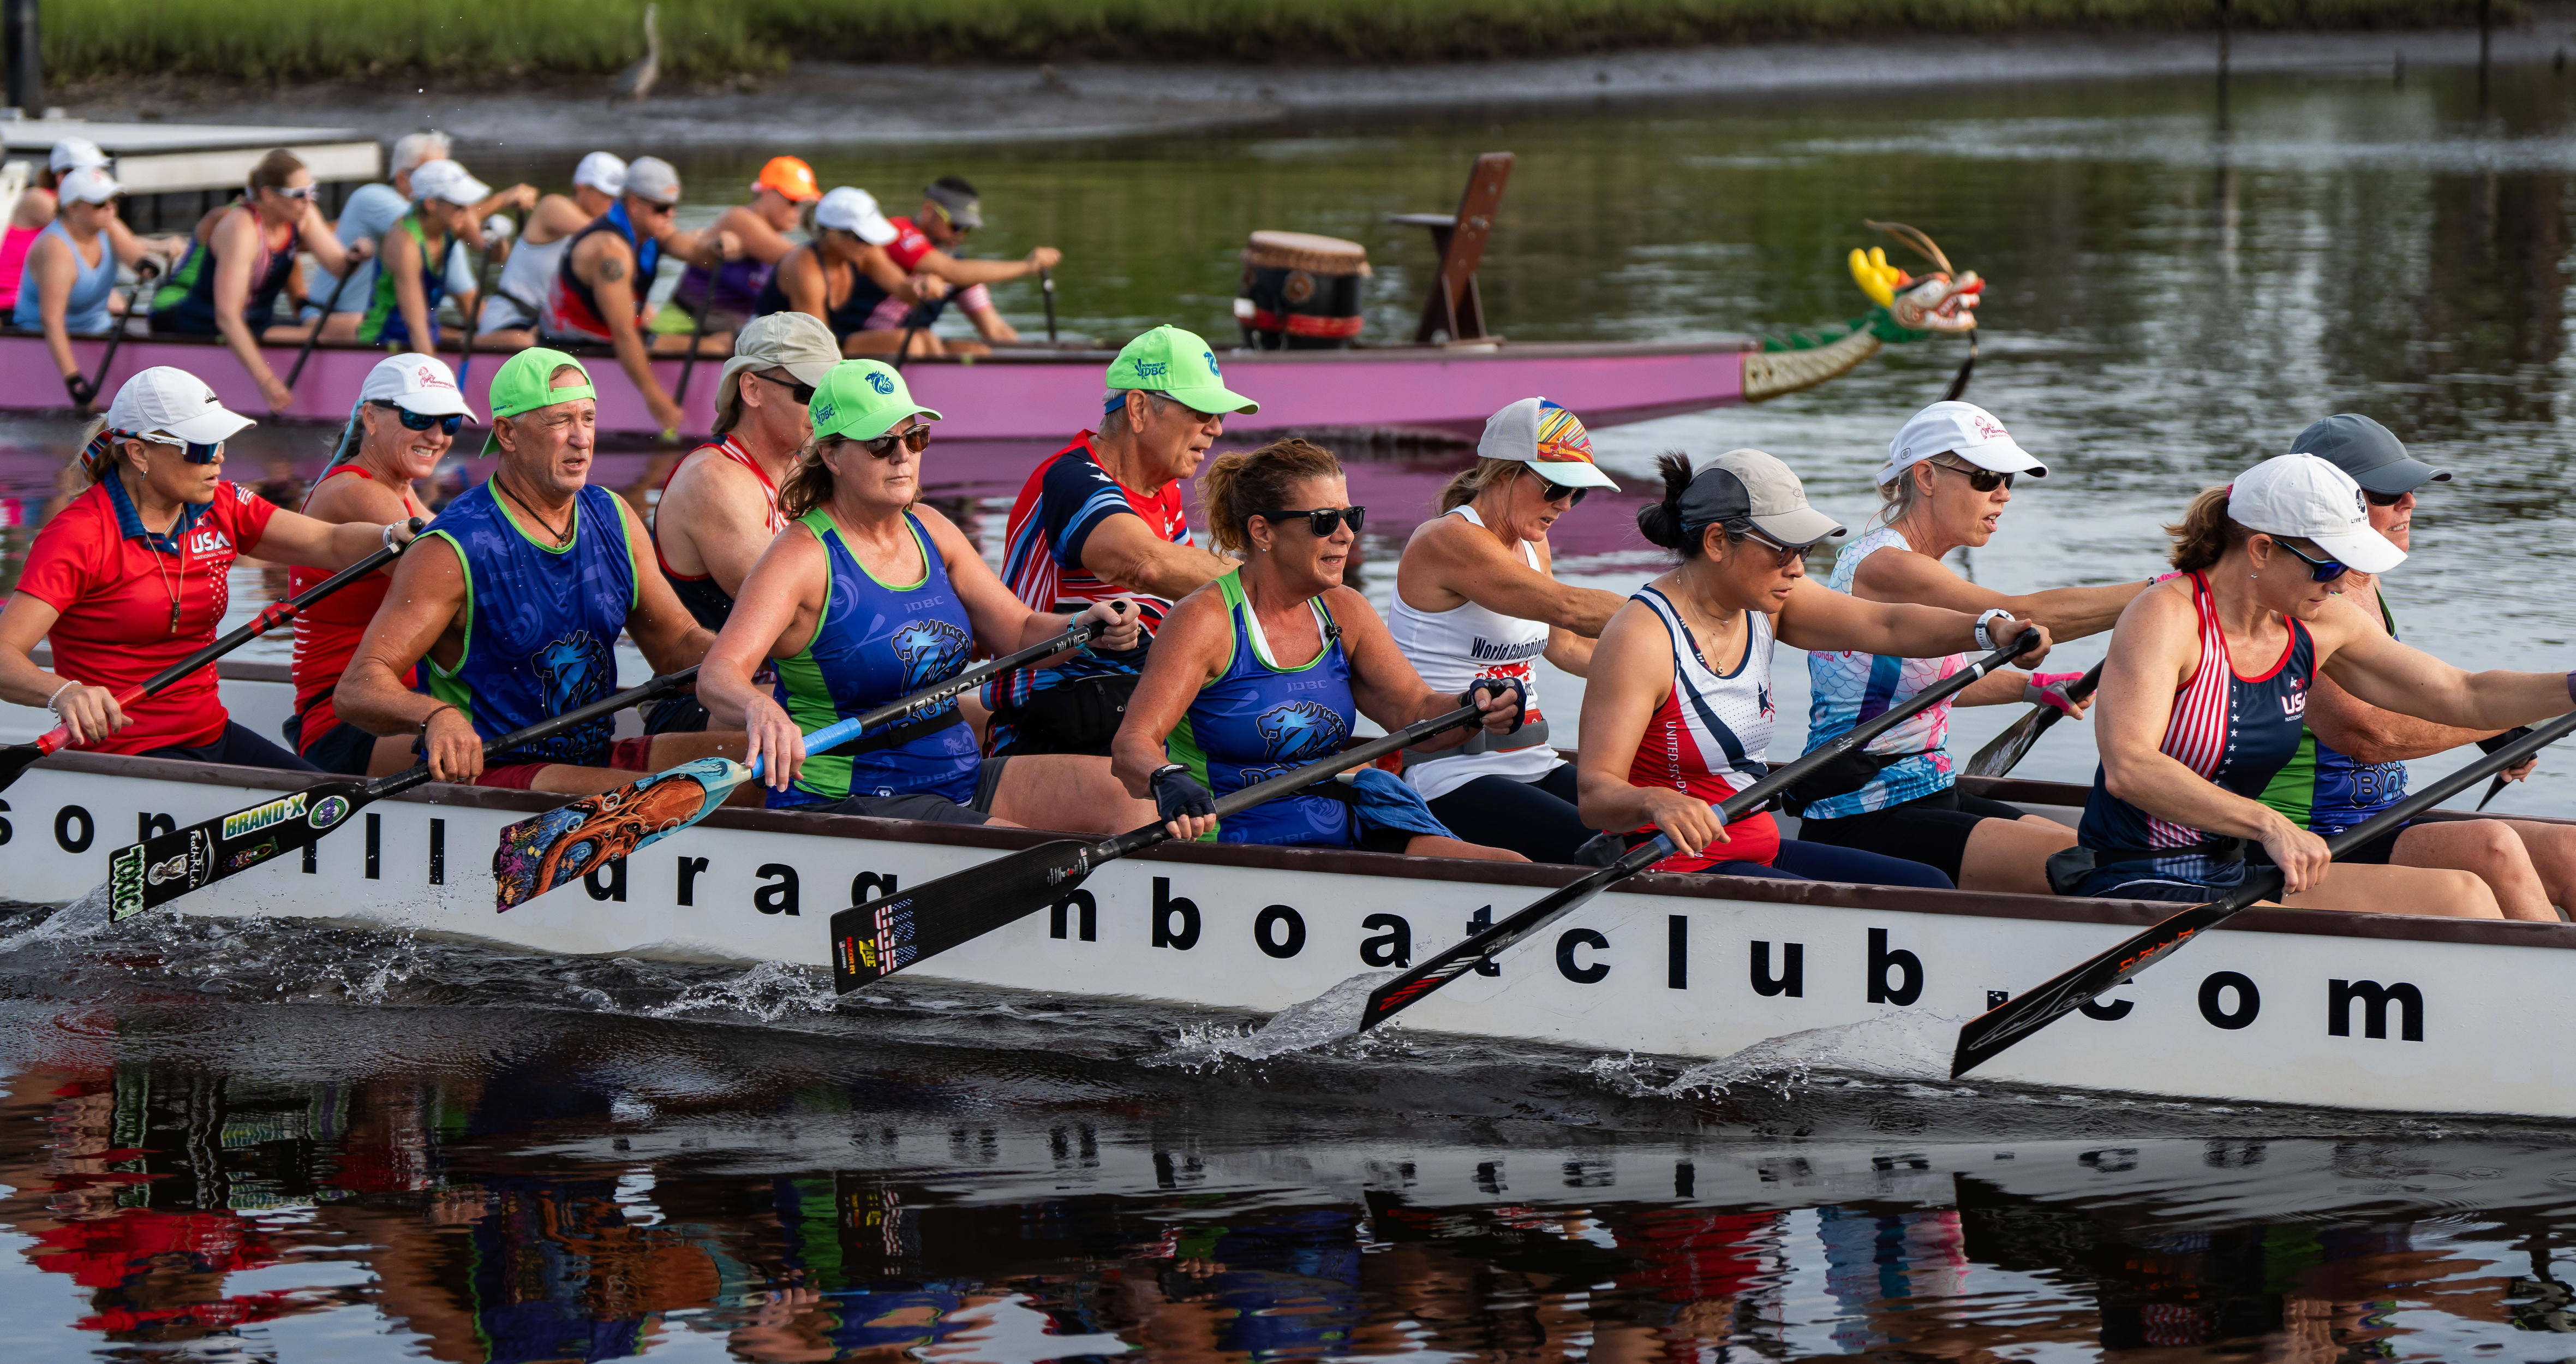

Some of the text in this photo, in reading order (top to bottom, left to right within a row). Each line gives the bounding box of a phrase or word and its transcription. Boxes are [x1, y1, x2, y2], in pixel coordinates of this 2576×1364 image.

[191, 529, 232, 553] USA
[193, 552, 218, 561] NATIONAL
[904, 595, 945, 613] JDBC
[1471, 637, 1510, 660] World
[1286, 680, 1328, 693] JDBC
[1666, 722, 1679, 762] UNITED
[224, 794, 306, 839] BRAND-X
[874, 898, 918, 976] USA
[846, 937, 856, 974] RAZOR R1
